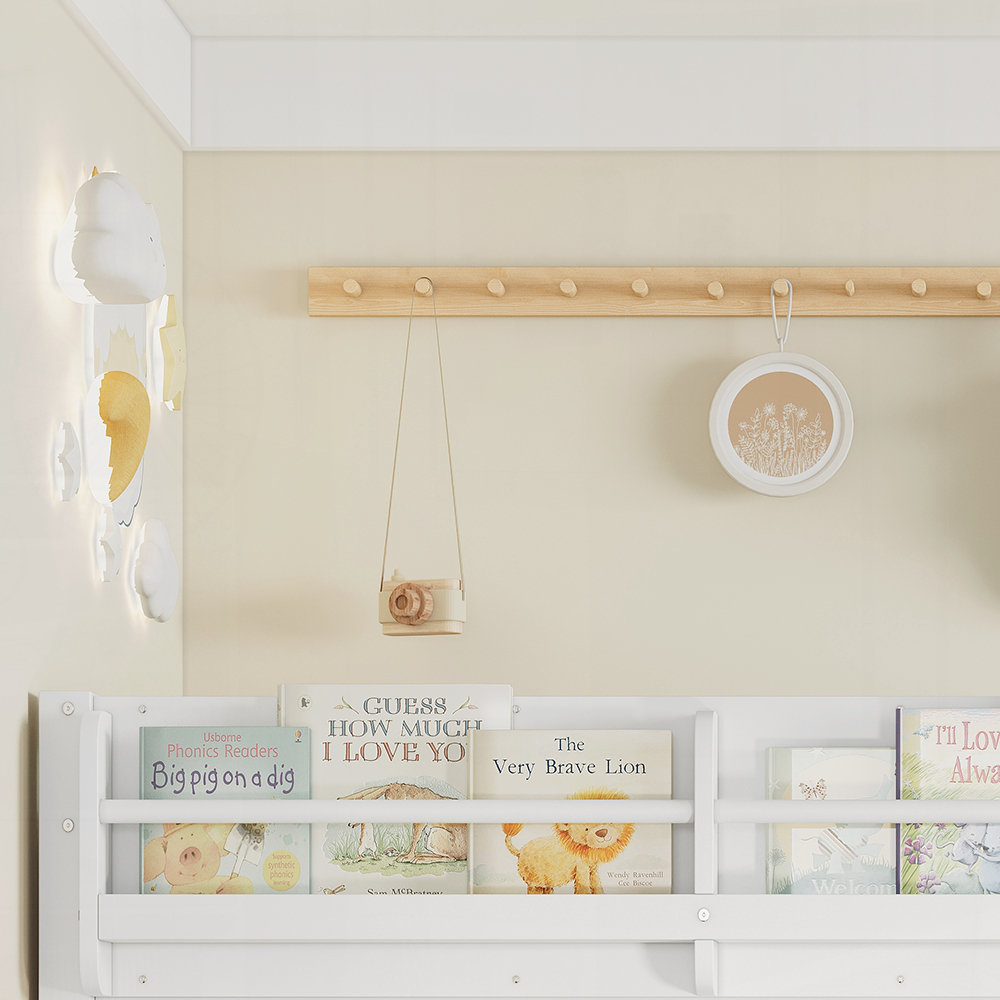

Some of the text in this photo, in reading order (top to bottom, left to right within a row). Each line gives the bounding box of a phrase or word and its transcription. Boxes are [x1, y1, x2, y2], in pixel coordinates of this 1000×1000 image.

[363, 696, 448, 715] GUESS
[203, 731, 242, 743] Usborne
[328, 719, 483, 738] HOW MUCH
[935, 724, 957, 746] I'll
[166, 743, 279, 759] Phonics Readers
[322, 741, 468, 763] I LOVE YO
[553, 736, 586, 752] The
[151, 760, 296, 795] Big pig on a dig
[492, 757, 647, 781] Very Brave Lion
[607, 871, 631, 880] Wendy
[811, 879, 897, 895] Welcom
